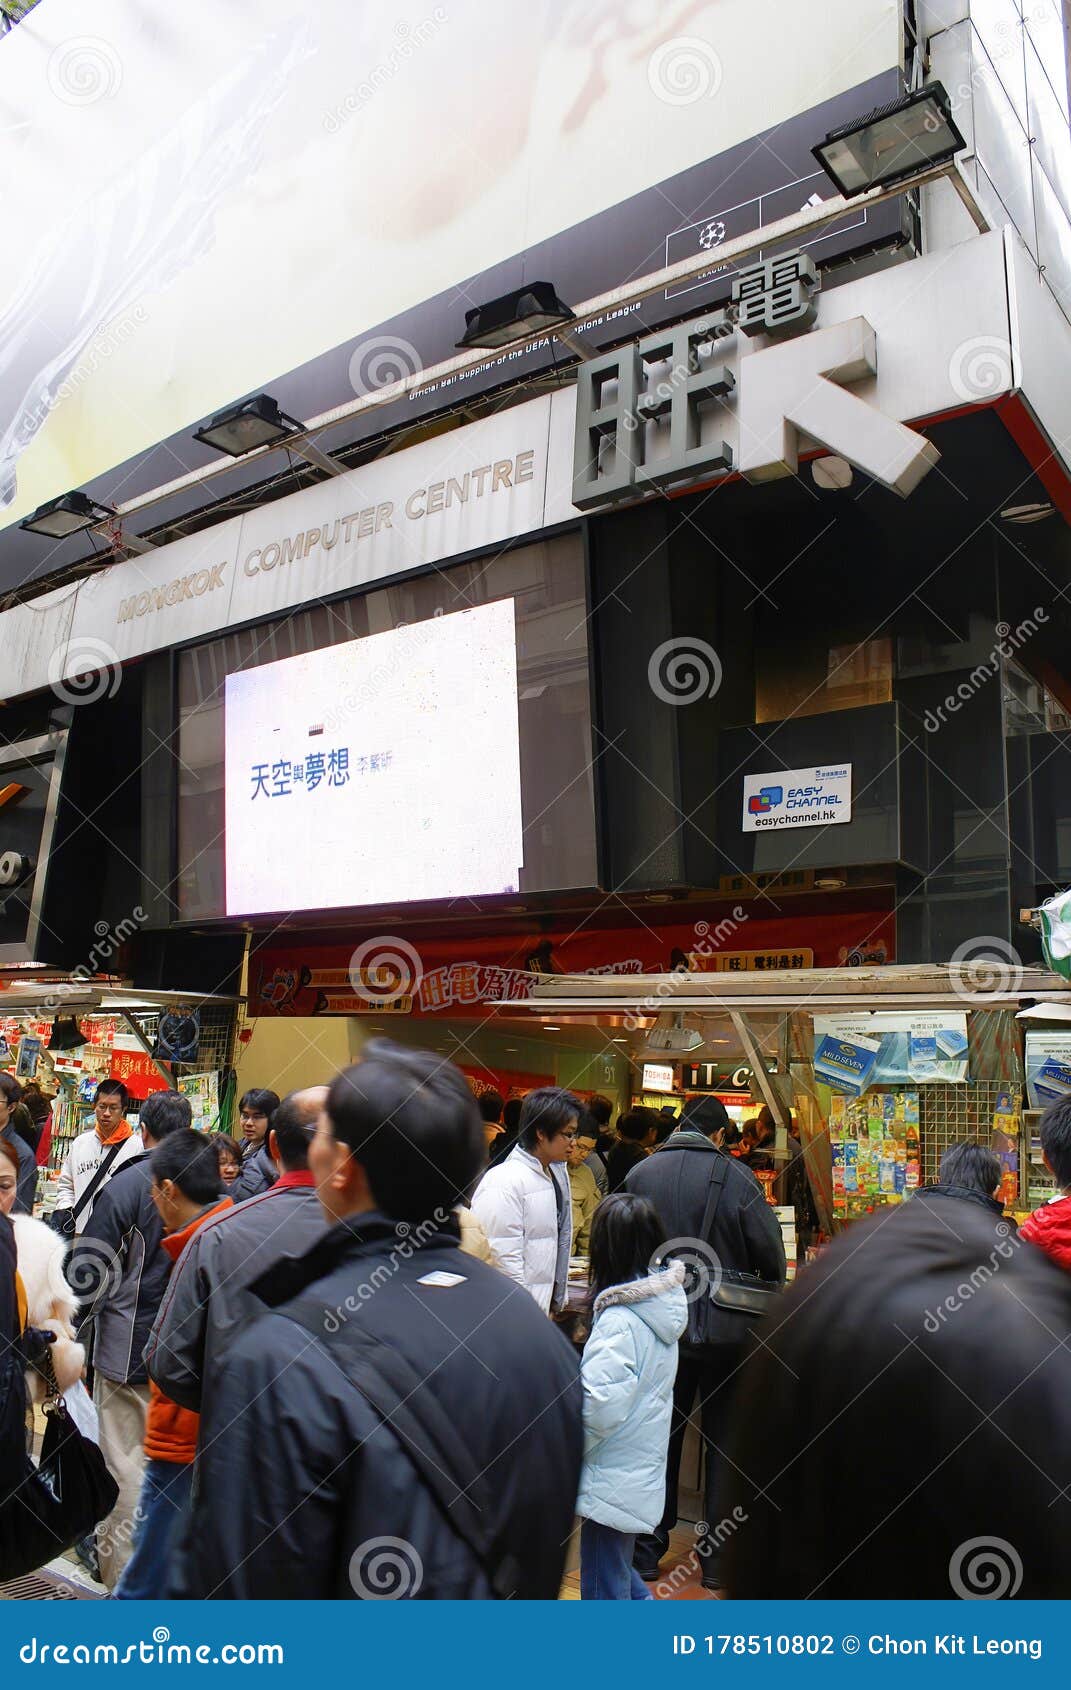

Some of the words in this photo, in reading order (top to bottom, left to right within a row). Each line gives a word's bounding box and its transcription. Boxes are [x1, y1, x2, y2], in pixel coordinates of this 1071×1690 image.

[731, 247, 818, 338] 電
[441, 374, 457, 388] Ball
[459, 360, 496, 379] Supplier
[497, 353, 507, 365] of
[508, 349, 523, 361] the
[525, 337, 550, 353] UEFA
[552, 317, 603, 343] Cpions
[606, 302, 641, 321] League
[572, 308, 742, 512] 旺
[116, 561, 227, 625] MONGKOK
[243, 500, 394, 578] COMPUTER
[404, 449, 535, 521] CENTRE
[251, 748, 350, 800] 天空與夢想
[786, 795, 842, 809] CHANNEL
[787, 786, 823, 798] EASY
[755, 810, 836, 827] easychannel.hk
[644, 1069, 671, 1080] TOSHIBA
[823, 1050, 841, 1061] MILD
[840, 1055, 865, 1069] SEVEN
